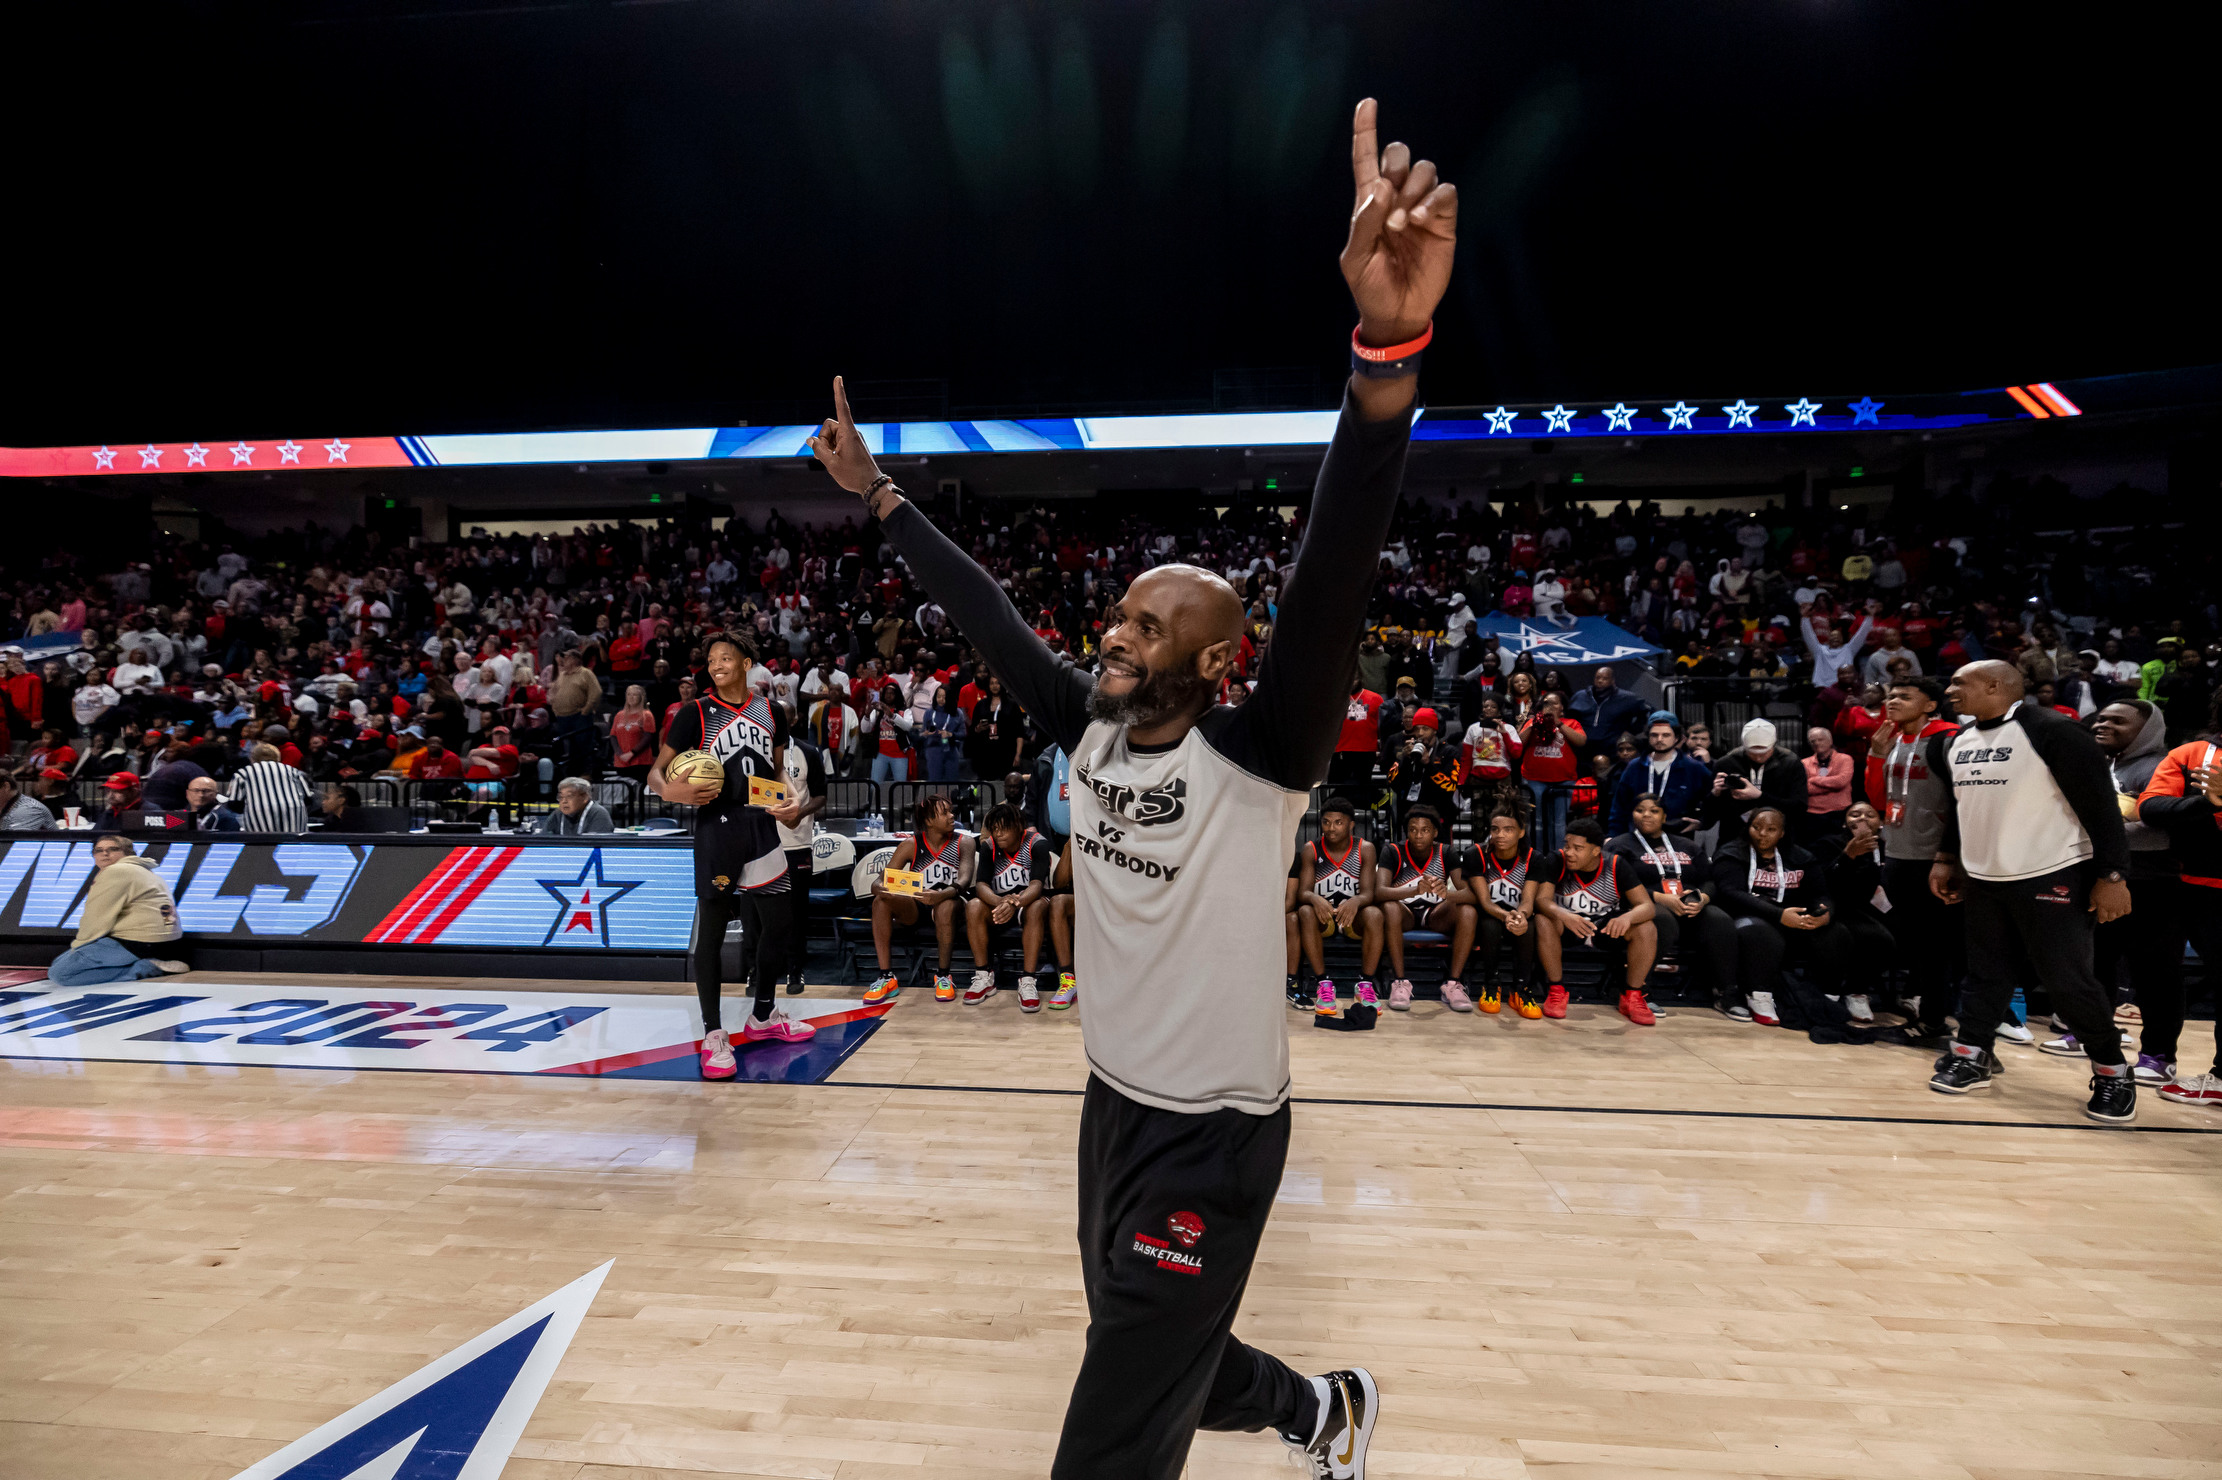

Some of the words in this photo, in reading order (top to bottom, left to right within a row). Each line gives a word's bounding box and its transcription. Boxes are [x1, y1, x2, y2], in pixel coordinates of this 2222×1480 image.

[714, 722, 773, 762] ILLCRE
[741, 756, 755, 777] 0
[1955, 747, 2013, 764] HHS
[1099, 820, 1126, 843] VS
[0, 991, 213, 1038] M
[122, 998, 611, 1052] 2024
[1133, 1241, 1203, 1267] BASKETBALL
